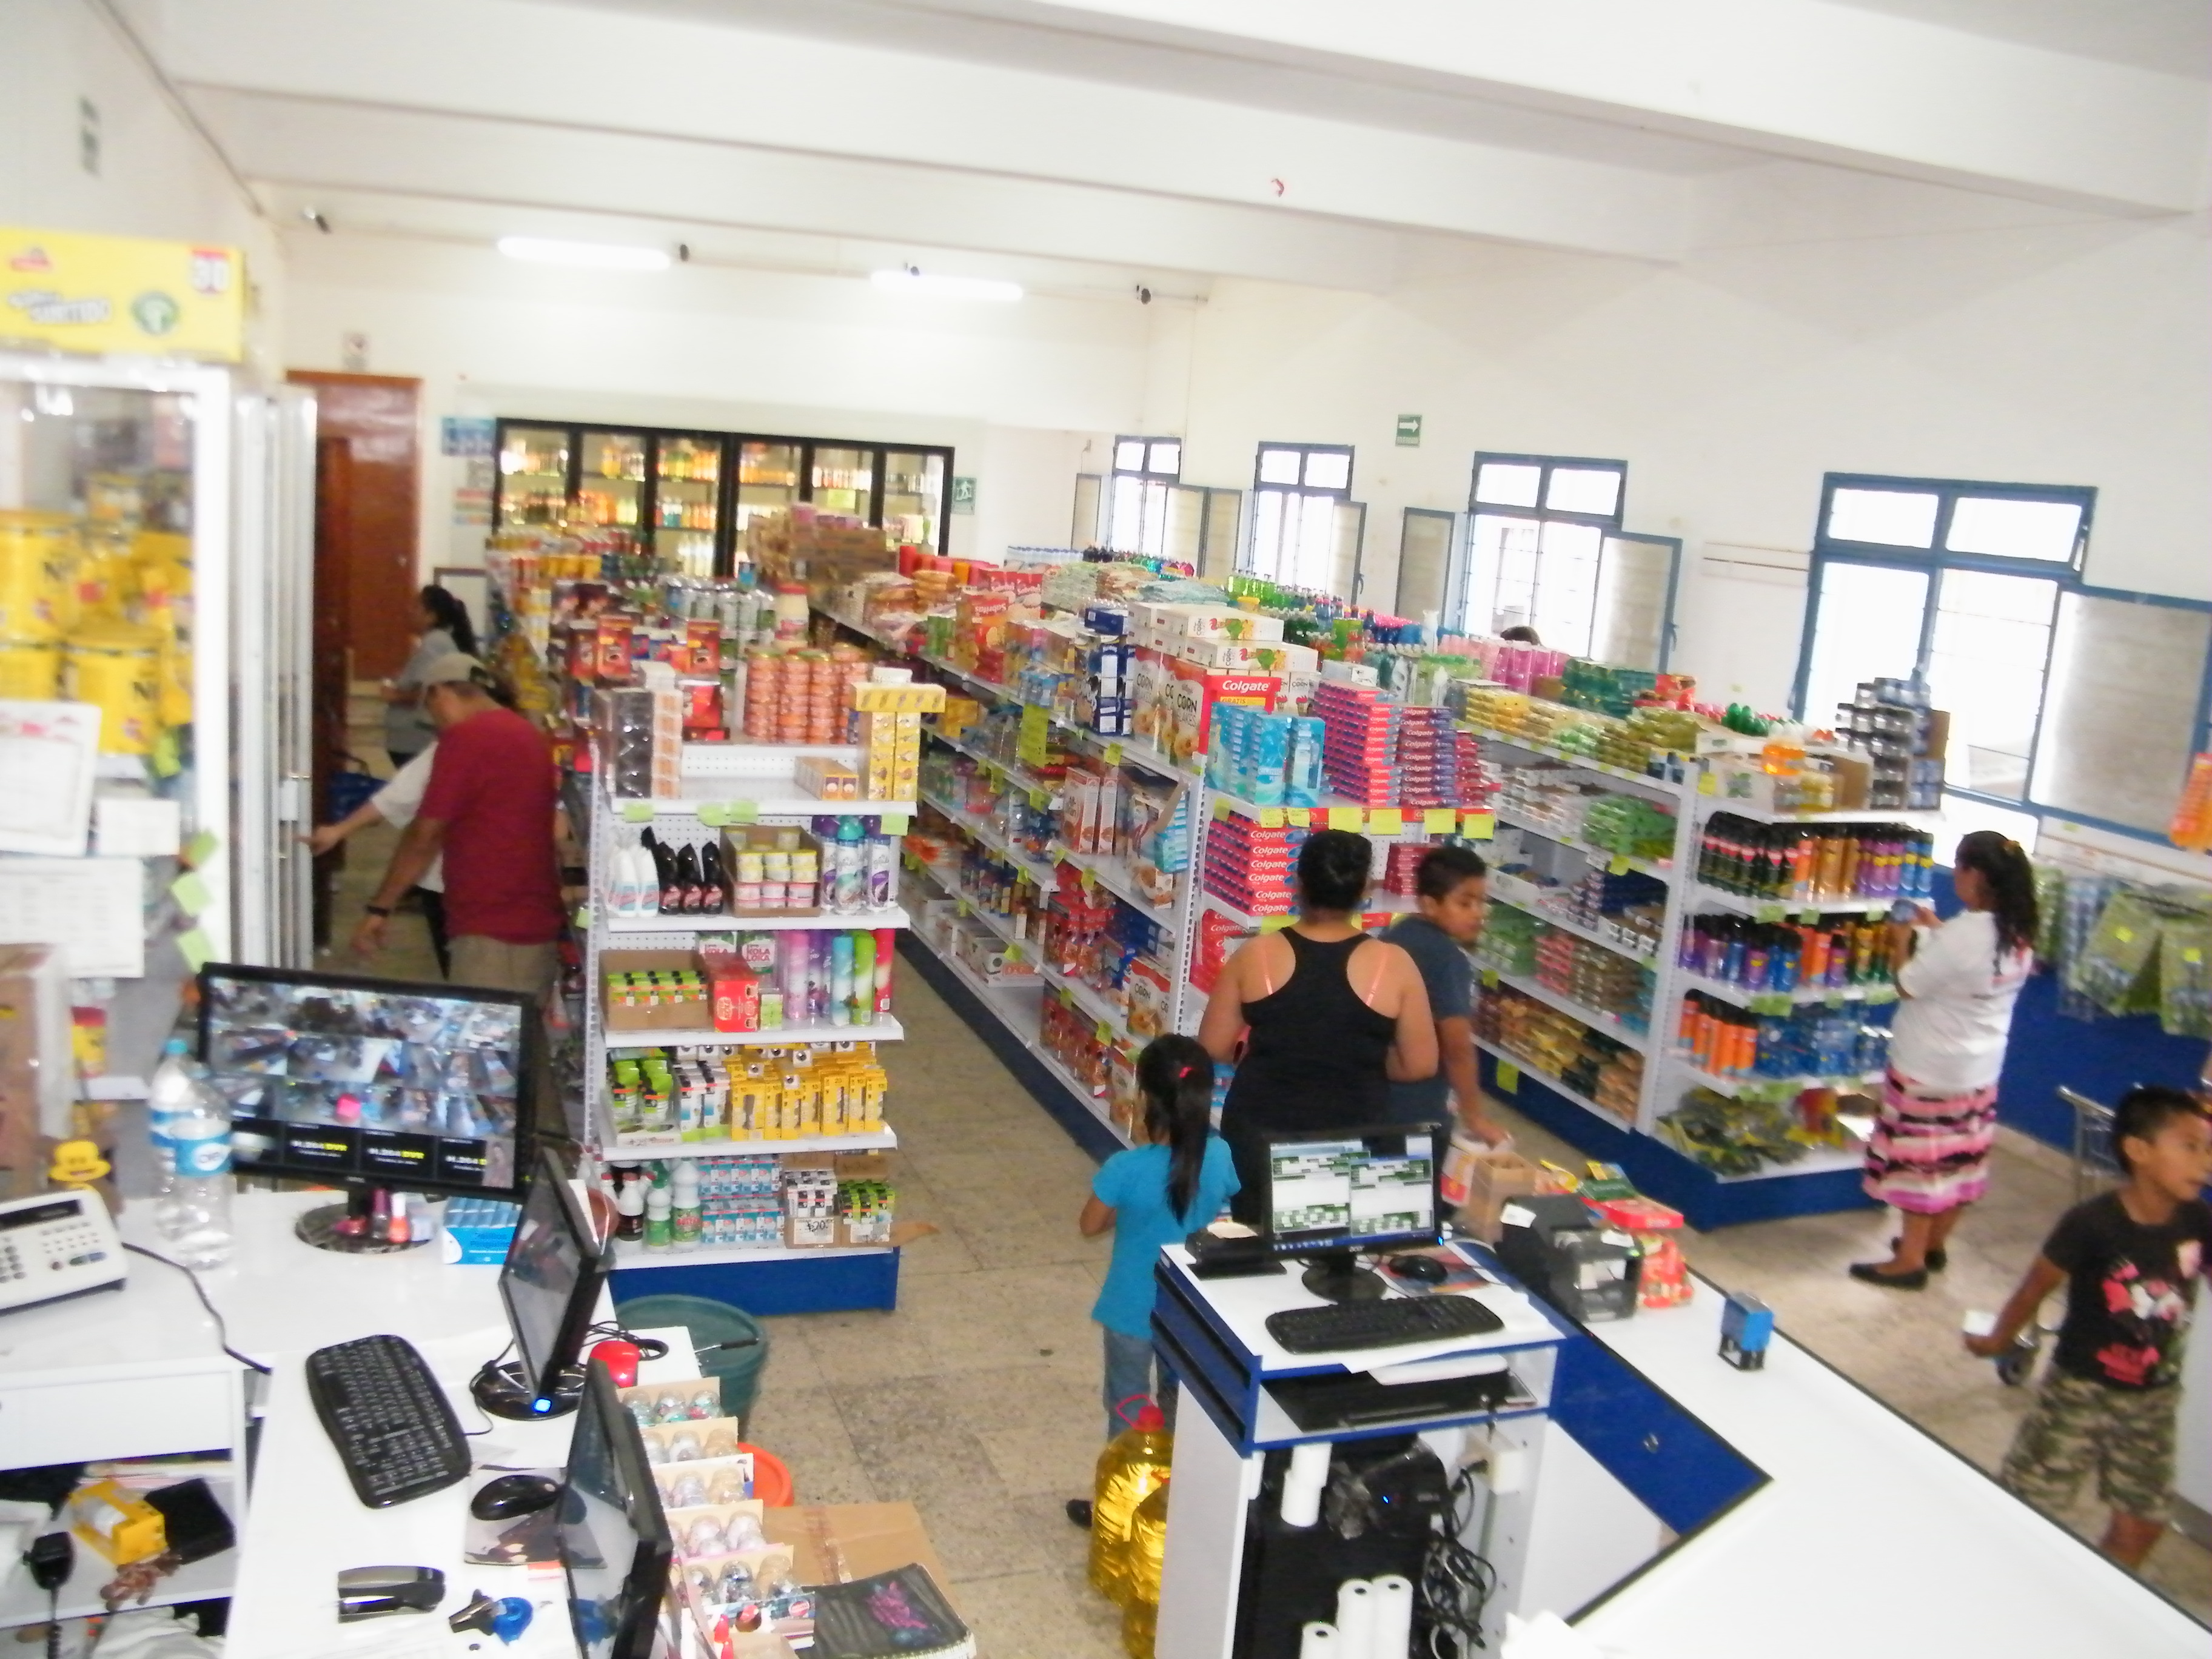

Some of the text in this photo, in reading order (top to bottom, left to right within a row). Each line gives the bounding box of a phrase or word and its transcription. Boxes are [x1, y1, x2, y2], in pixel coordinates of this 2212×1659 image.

[1222, 680, 1269, 694] Colgate
[1177, 694, 1197, 712] CORN
[1250, 831, 1286, 840] Colgate
[1253, 846, 1289, 856] Colgate
[1251, 860, 1287, 870] Colgate
[1248, 874, 1285, 883] Colgate
[1255, 891, 1292, 900] Colgate
[1252, 904, 1289, 914] Colgate
